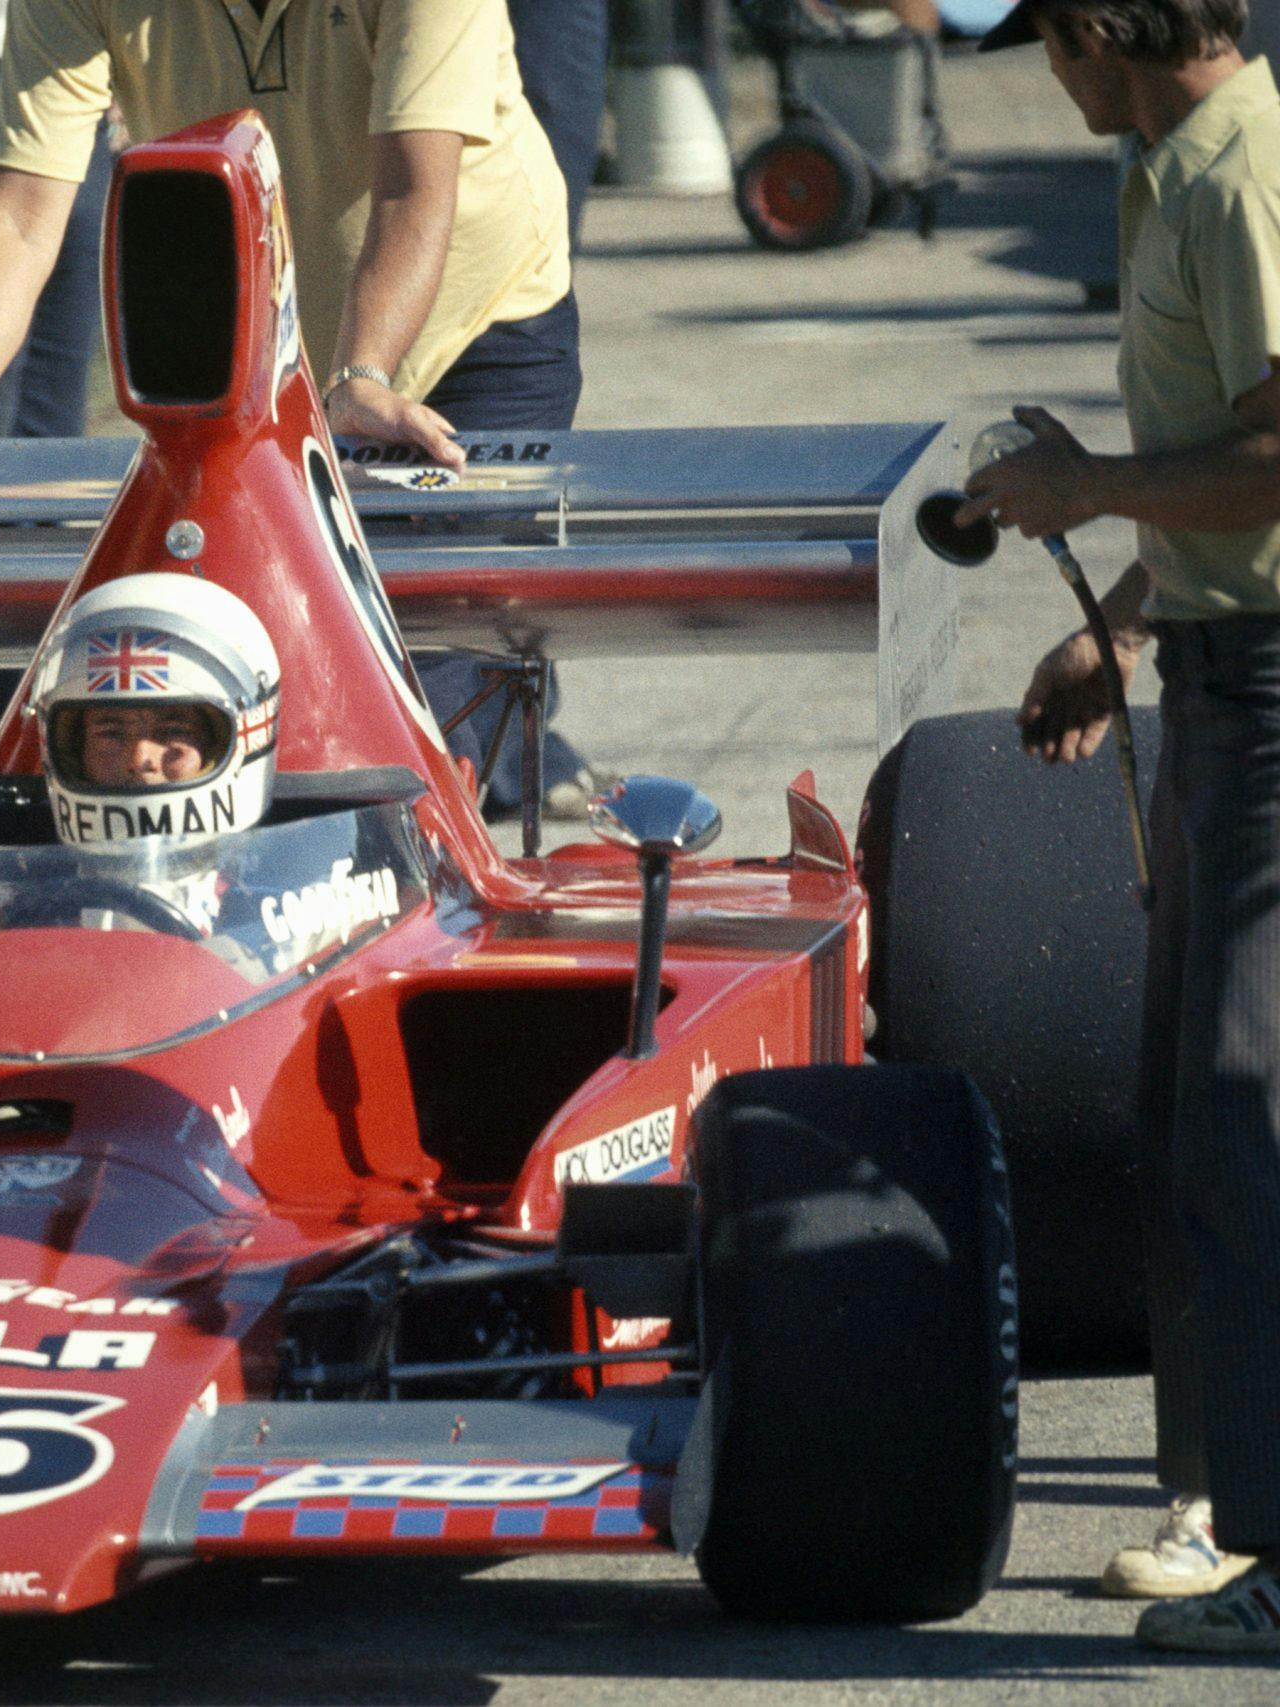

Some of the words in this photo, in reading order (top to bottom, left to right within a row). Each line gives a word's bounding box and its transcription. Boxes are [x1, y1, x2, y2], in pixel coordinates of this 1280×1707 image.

[57, 785, 235, 844] REDMAN
[601, 1113, 670, 1175] DOUGLASS
[296, 1472, 580, 1489] STEED
